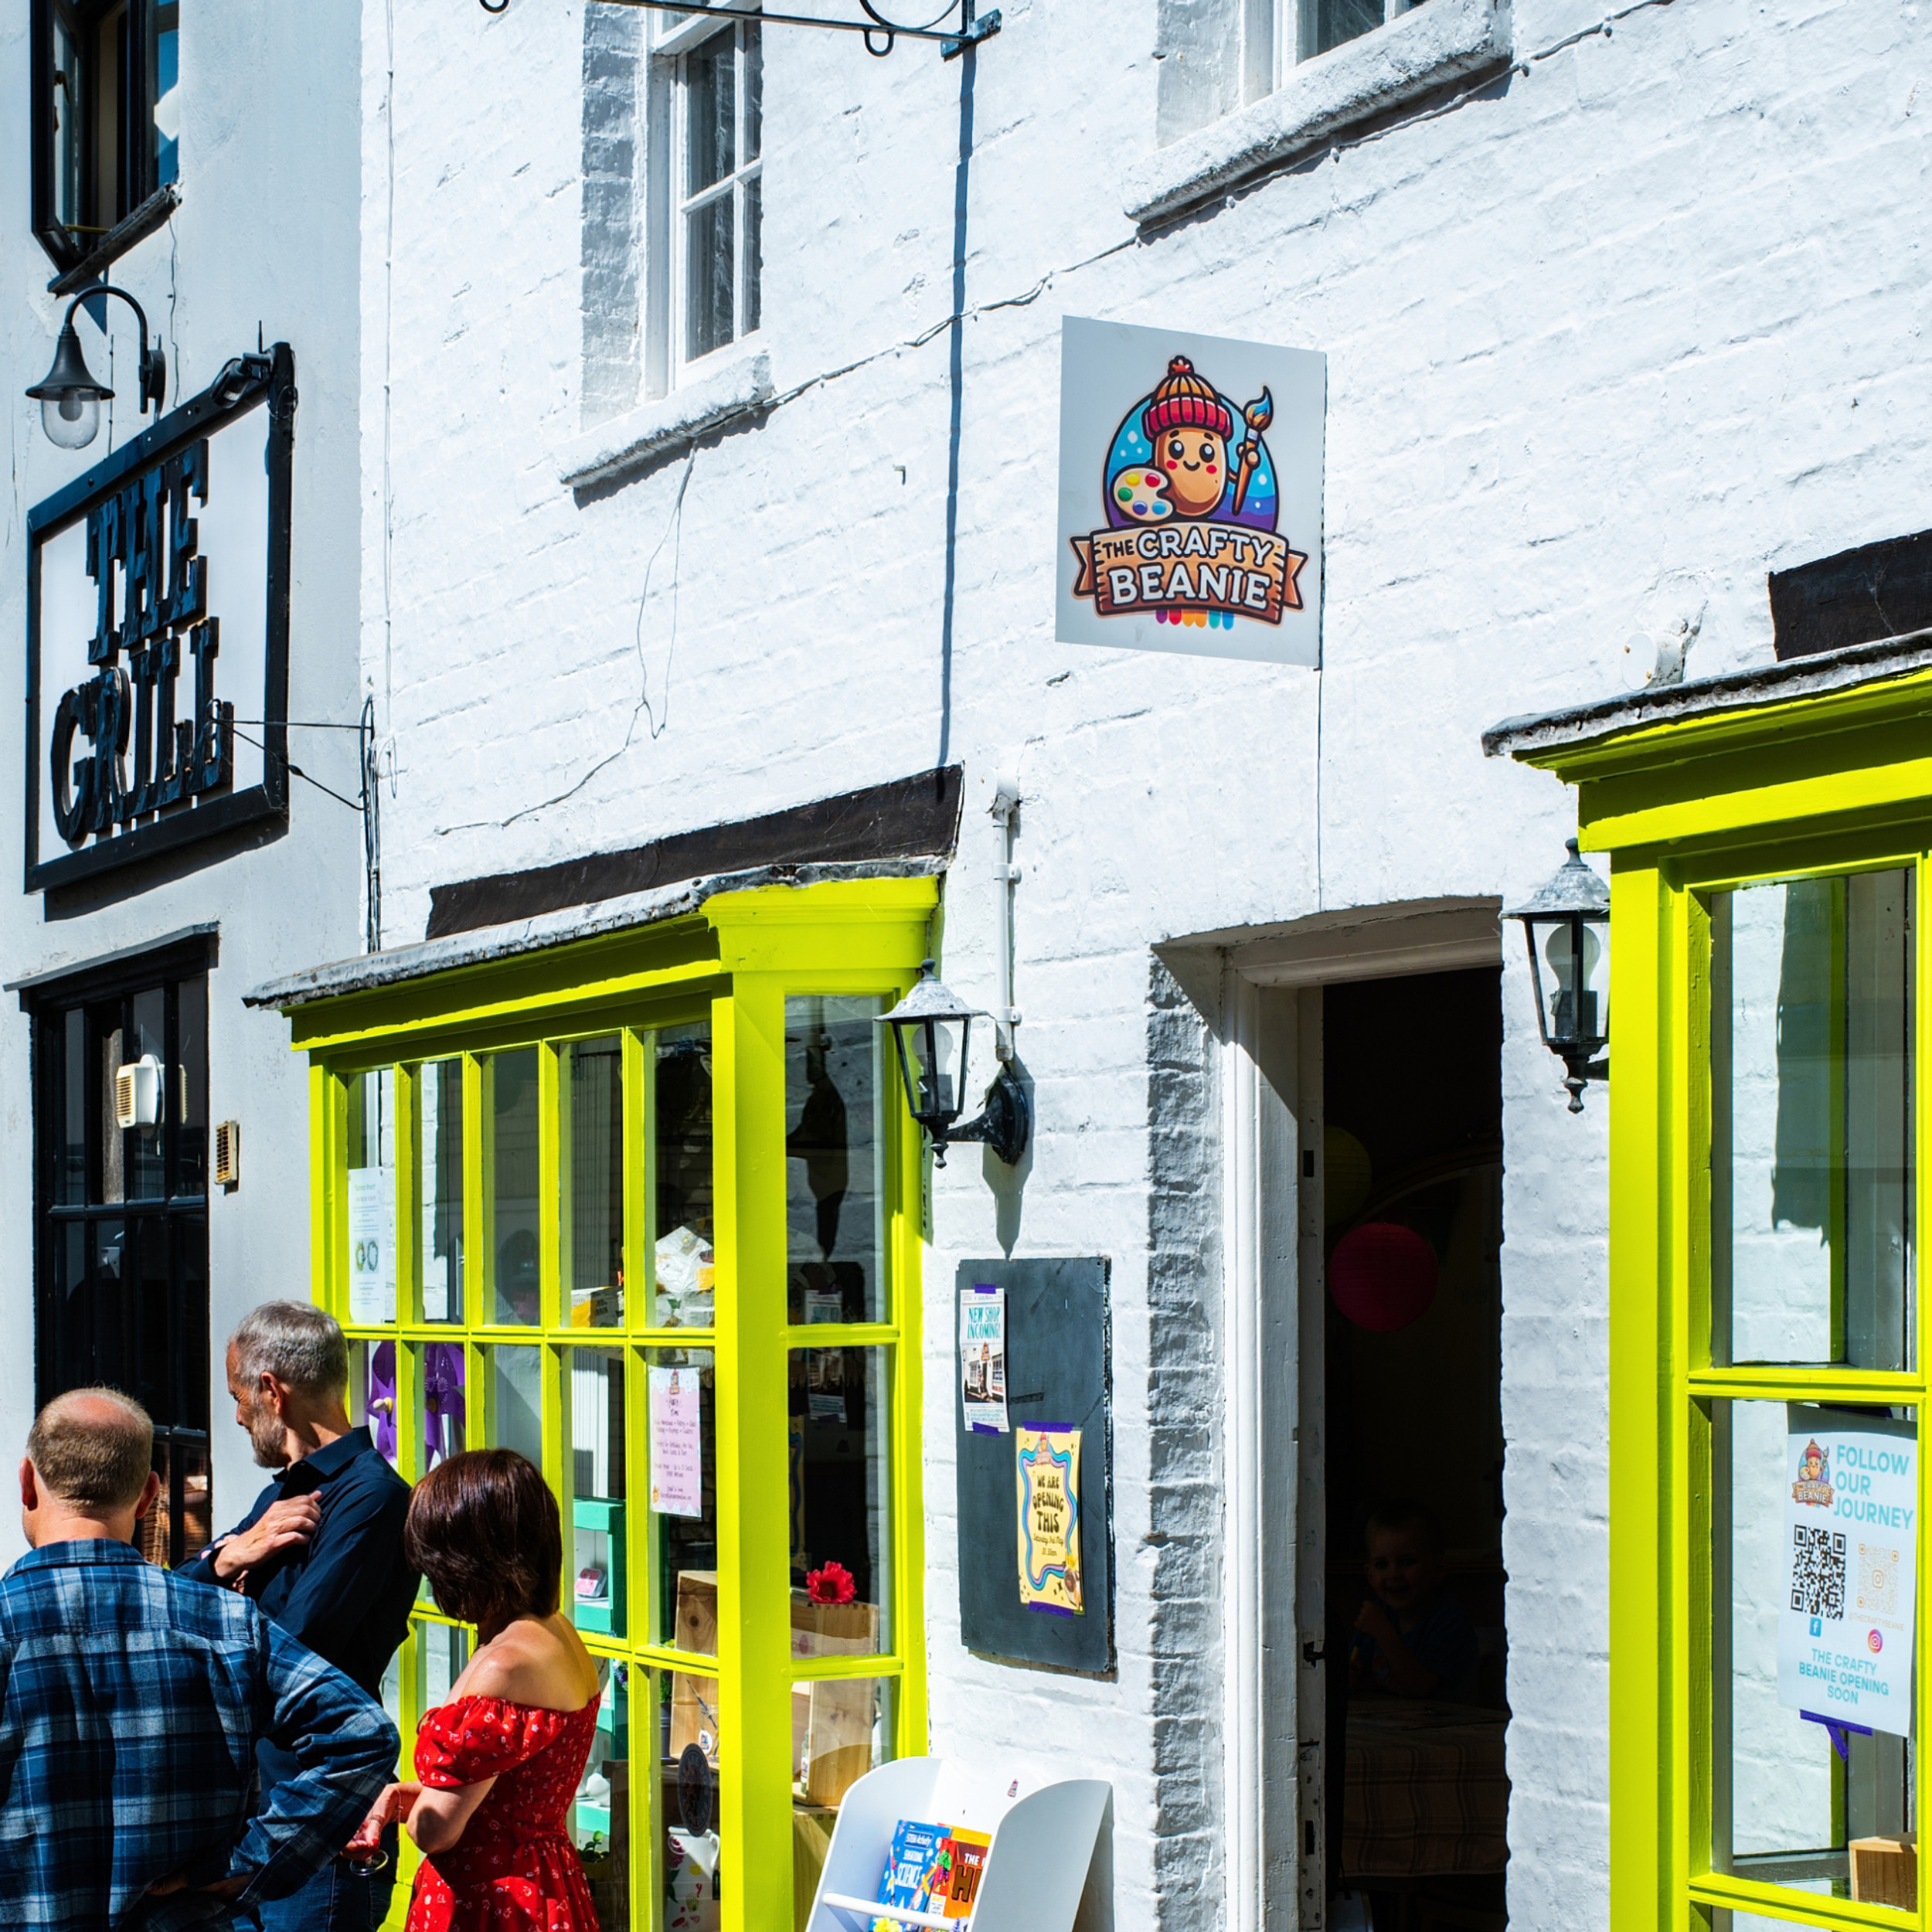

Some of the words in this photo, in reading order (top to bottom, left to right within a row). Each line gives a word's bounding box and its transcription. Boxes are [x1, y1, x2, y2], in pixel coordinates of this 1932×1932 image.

[87, 438, 209, 666] THE
[1101, 539, 1135, 559] THE
[1138, 528, 1272, 566] CRAFTY
[1108, 562, 1271, 610] BEANIE
[51, 617, 233, 844] GRILL
[968, 1307, 983, 1323] NEW
[985, 1306, 1001, 1322] SHOP
[968, 1323, 1001, 1339] INCOMING!
[1836, 1444, 1910, 1476] FOLLOW
[1037, 1475, 1046, 1489] WE
[1047, 1476, 1060, 1490] ARE
[1835, 1471, 1871, 1496] OUR
[1032, 1492, 1064, 1512] OPENING
[1798, 1491, 1828, 1504] BEANIE
[1036, 1511, 1060, 1533] THIS
[1833, 1496, 1914, 1530] JOURNEY
[1811, 1648, 1832, 1665] THE
[1835, 1654, 1878, 1675] CRAFTY
[1799, 1662, 1837, 1683] BEANIE
[1839, 1672, 1889, 1696] OPENING
[1827, 1685, 1859, 1705] SOON
[964, 1852, 980, 1866] THE
[895, 1862, 923, 1889] SCIENCE
